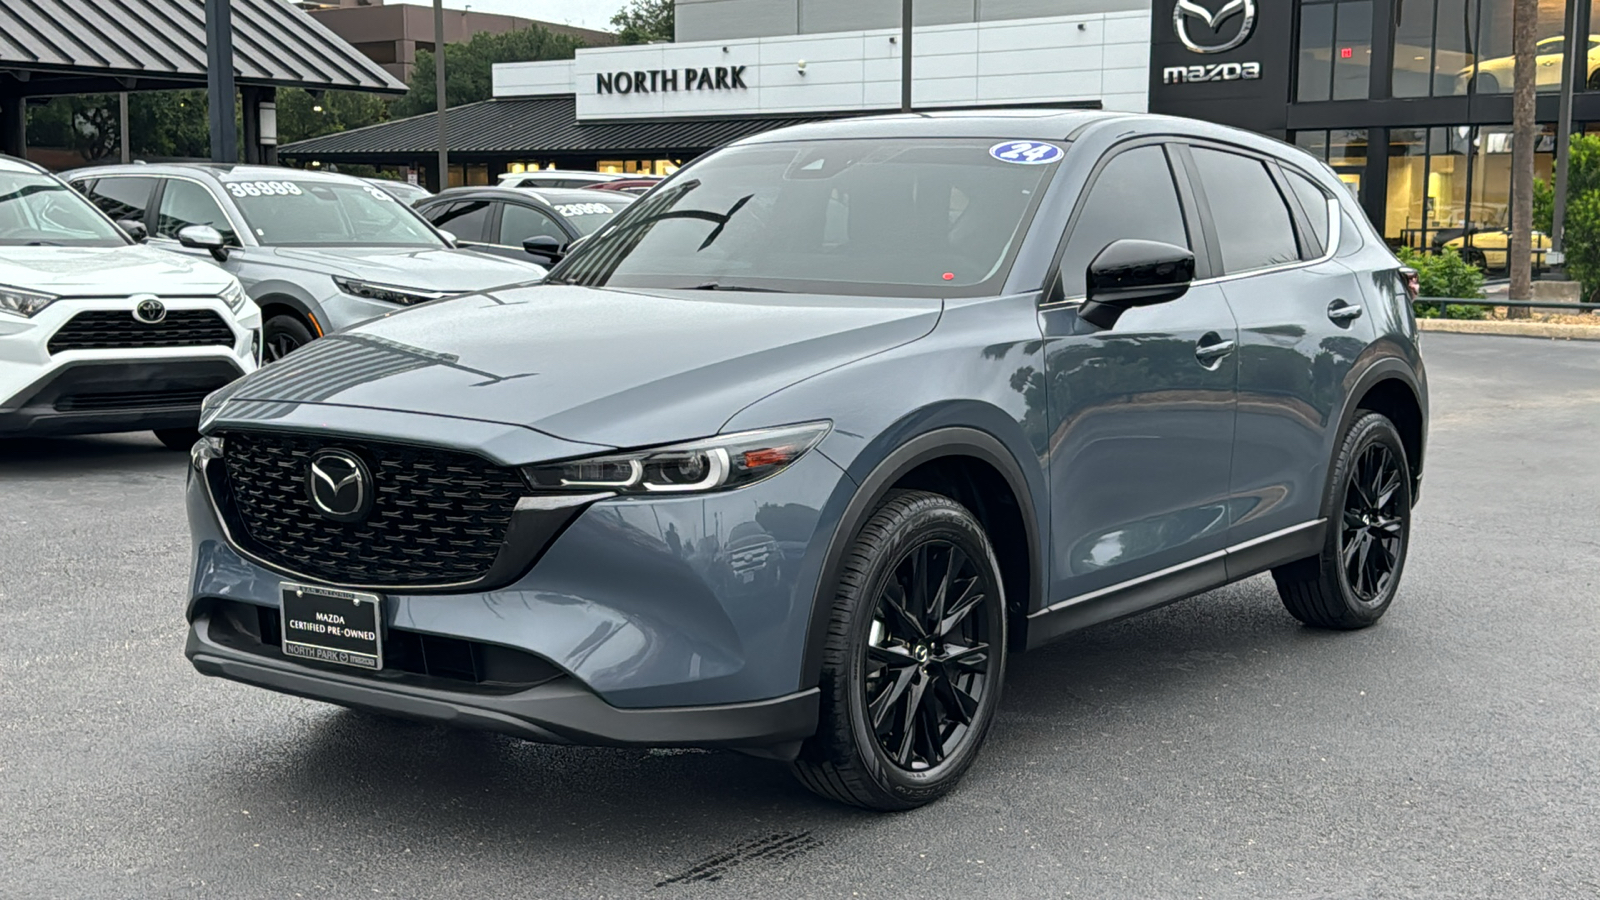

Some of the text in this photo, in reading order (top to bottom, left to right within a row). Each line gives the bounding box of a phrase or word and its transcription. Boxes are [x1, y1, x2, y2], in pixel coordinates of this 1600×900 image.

[596, 65, 748, 95] NORTH PARK
[999, 142, 1053, 162] 24
[225, 181, 303, 198] 36999
[315, 611, 346, 625] MAZDA
[289, 619, 376, 641] CERTIFIED PRE-OWNED
[288, 644, 315, 657] NORTH
[317, 648, 338, 661] PARK
